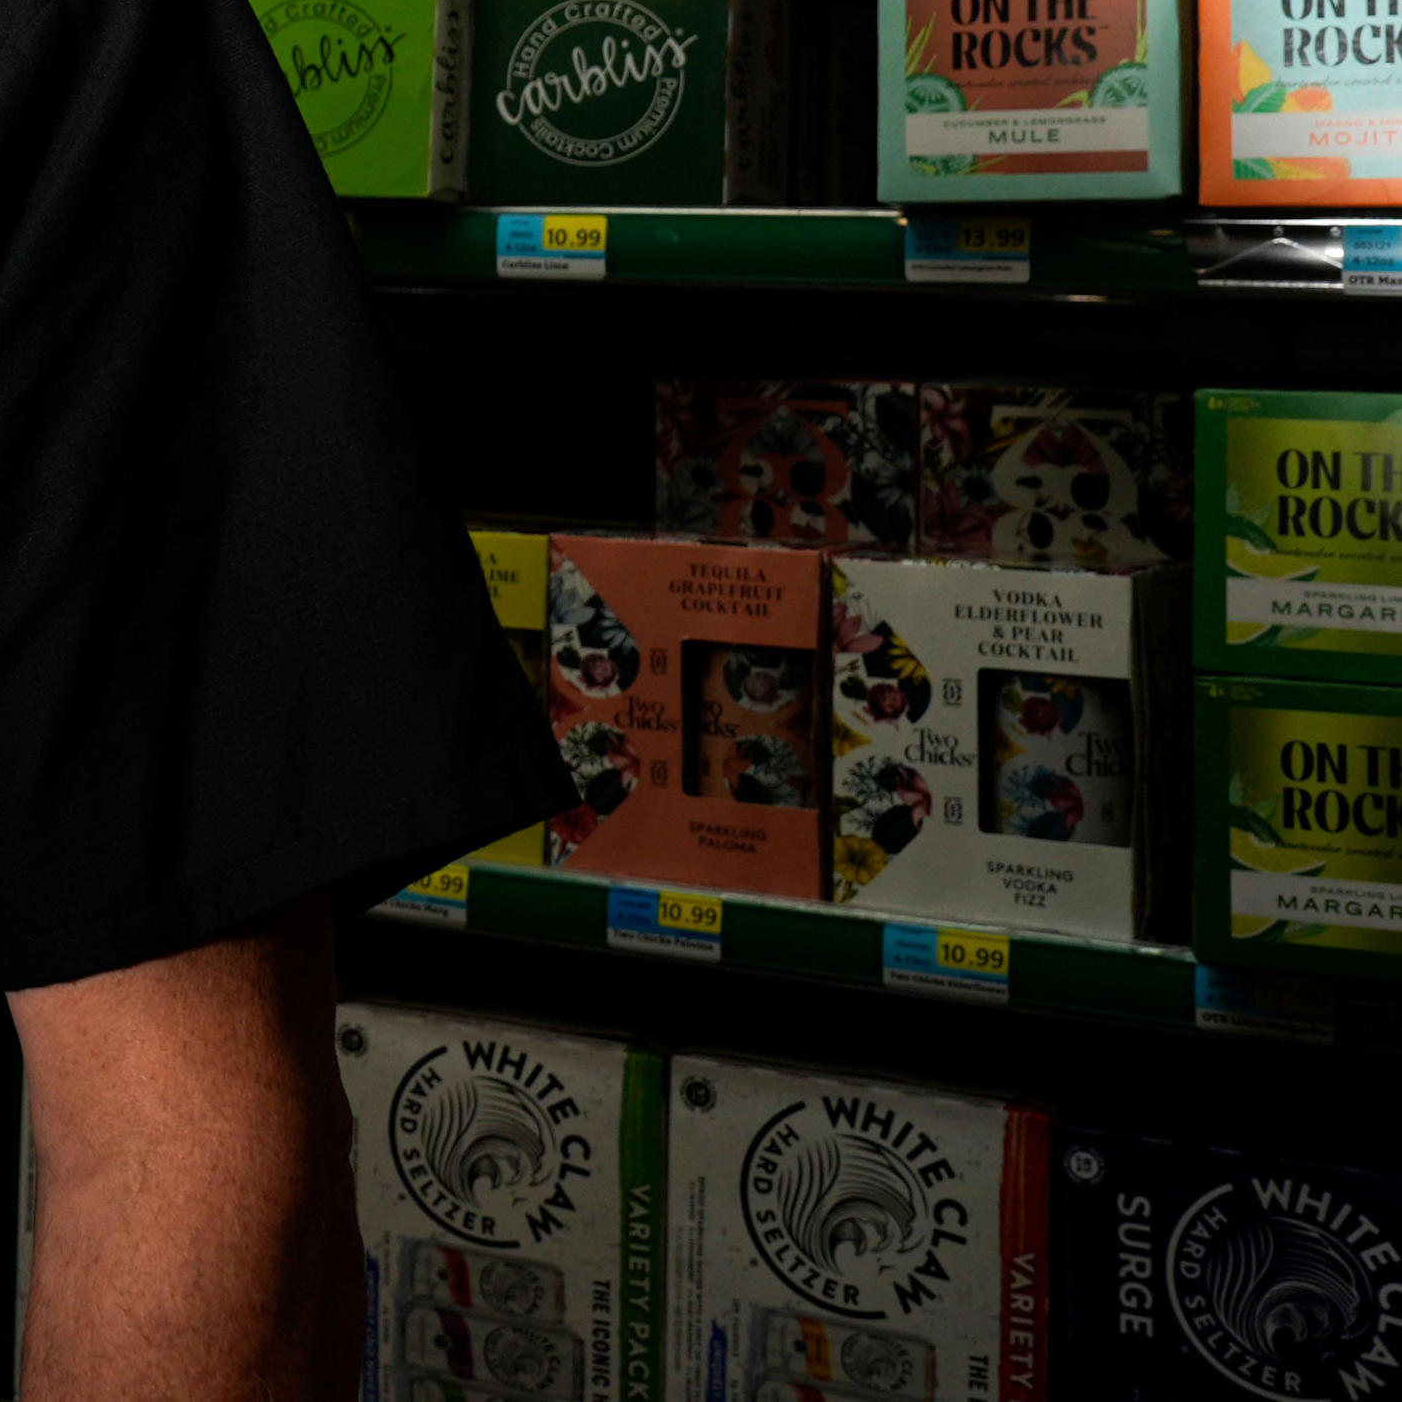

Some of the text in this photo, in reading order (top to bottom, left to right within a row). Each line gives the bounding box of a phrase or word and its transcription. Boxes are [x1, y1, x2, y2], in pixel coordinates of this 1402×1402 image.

[513, 1, 661, 78] Hand Crafted
[952, 25, 1098, 71] ROCKS
[496, 29, 697, 125] carbliss
[989, 129, 1060, 145] MULE
[547, 228, 601, 246] 10.99
[963, 228, 1025, 246] 13.99
[1277, 449, 1341, 491] ON
[993, 589, 1062, 609] VODKA
[954, 604, 1103, 631] ELDERFLOWER
[992, 624, 1064, 645] & PEAR
[978, 641, 1079, 663] COCKTAIL
[905, 745, 972, 767] Chicks
[913, 728, 959, 750] Two
[1281, 740, 1344, 782] ON
[987, 862, 1074, 883] SPARKLING
[1002, 877, 1058, 895] VODKA
[661, 901, 717, 924] 10.99
[943, 944, 1004, 967] 10.99
[399, 1067, 497, 1235] HARD SELTZER
[462, 1040, 593, 1244] WHITE CLAW
[755, 1125, 860, 1306] HARD SELTZER
[823, 1096, 969, 1314] WHITE CLAW
[1252, 1178, 1396, 1271] WHITE
[628, 1184, 652, 1309] VARIETY
[1118, 1194, 1153, 1336] SURGE
[1010, 1253, 1034, 1389] VARIETY
